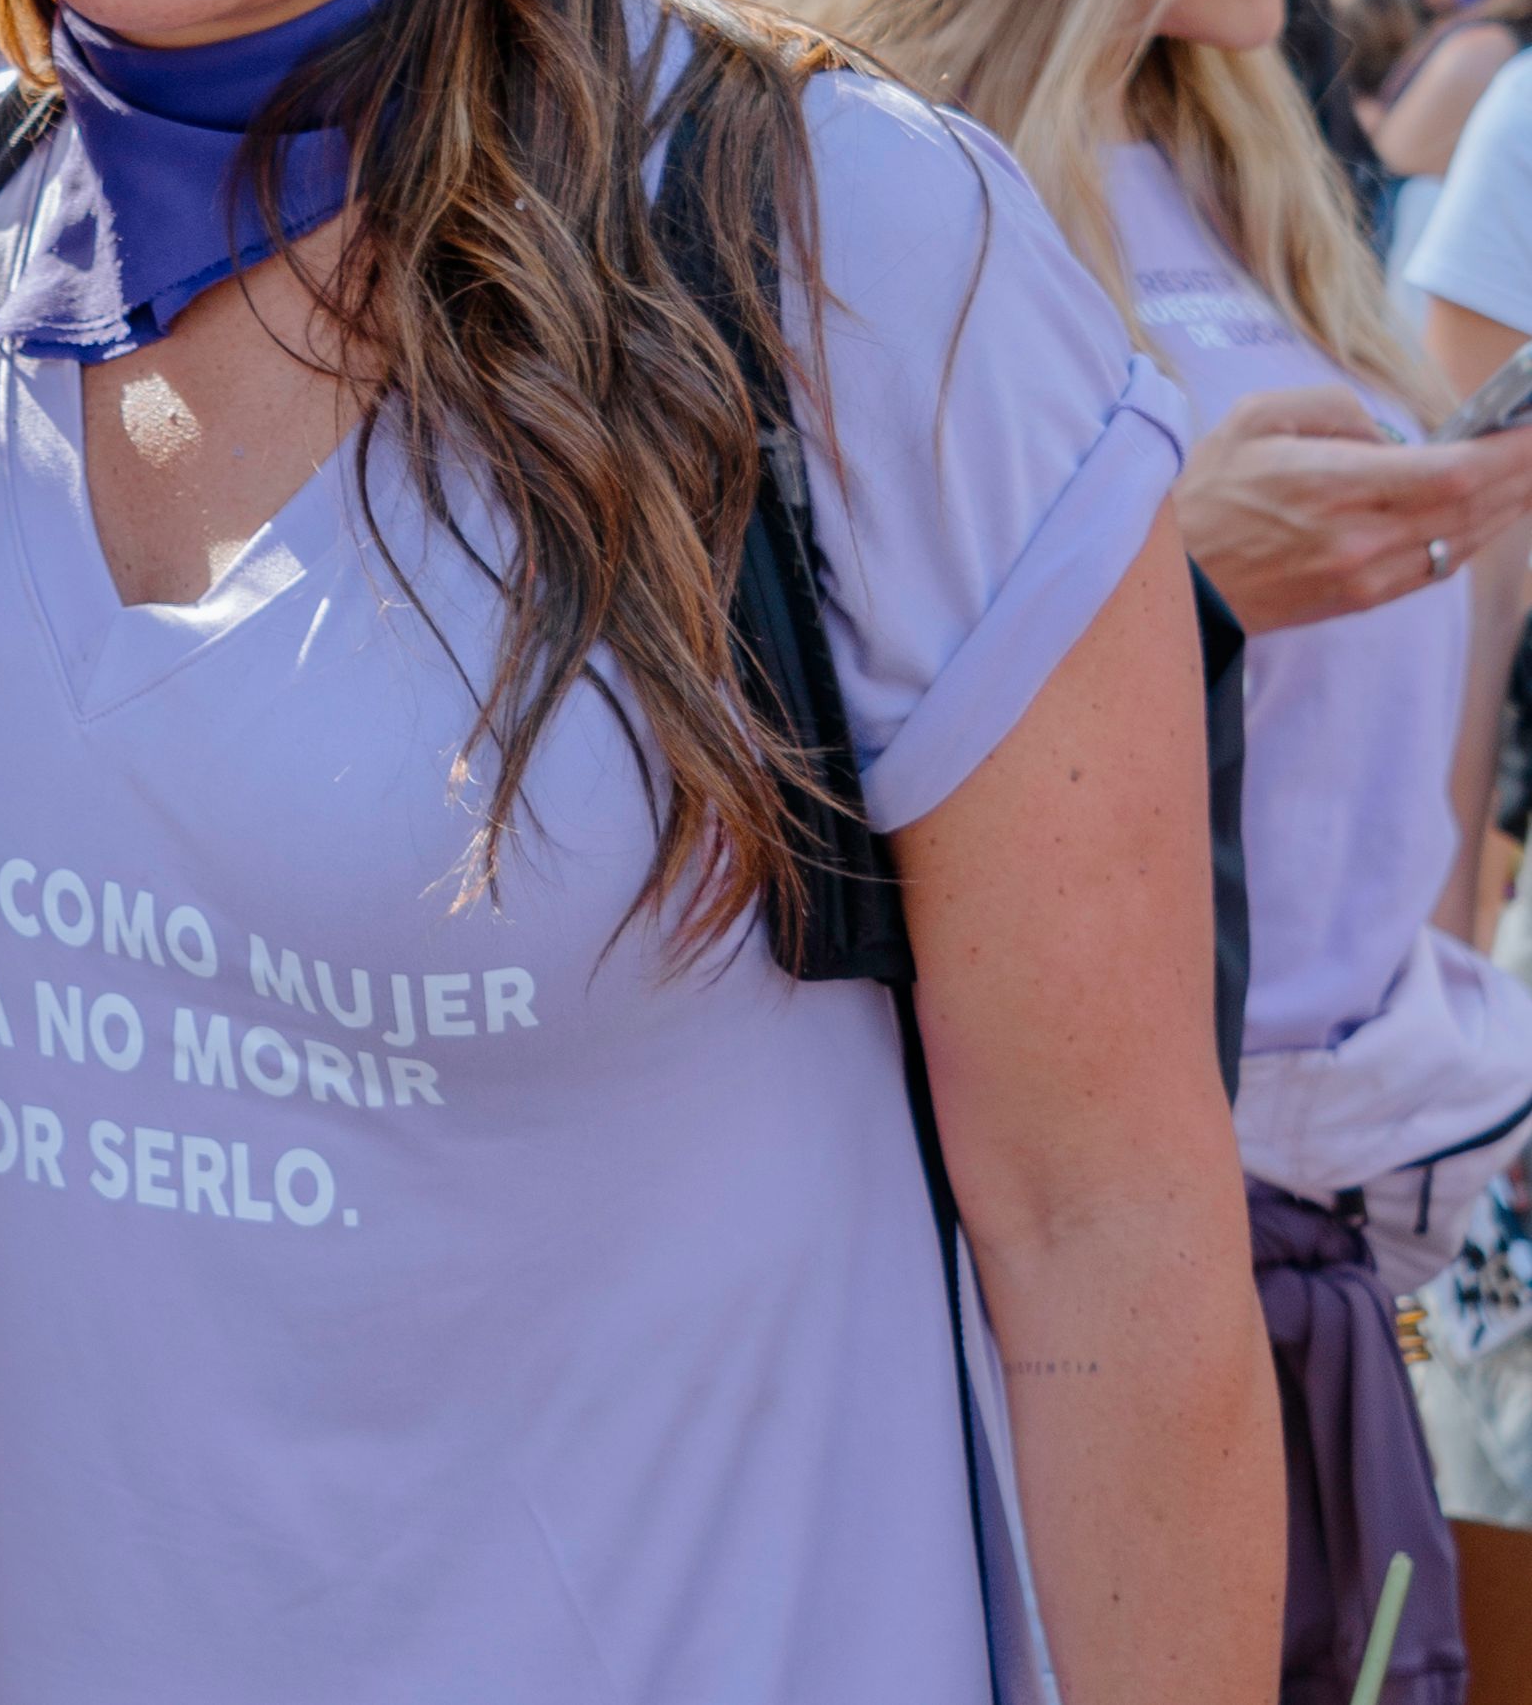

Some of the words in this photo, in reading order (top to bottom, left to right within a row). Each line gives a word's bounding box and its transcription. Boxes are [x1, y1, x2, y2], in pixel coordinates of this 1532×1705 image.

[34, 980, 144, 1072] NO
[173, 1007, 446, 1108] MORIR
[249, 933, 539, 1047] MUJER
[88, 1119, 359, 1227] SERLO.
